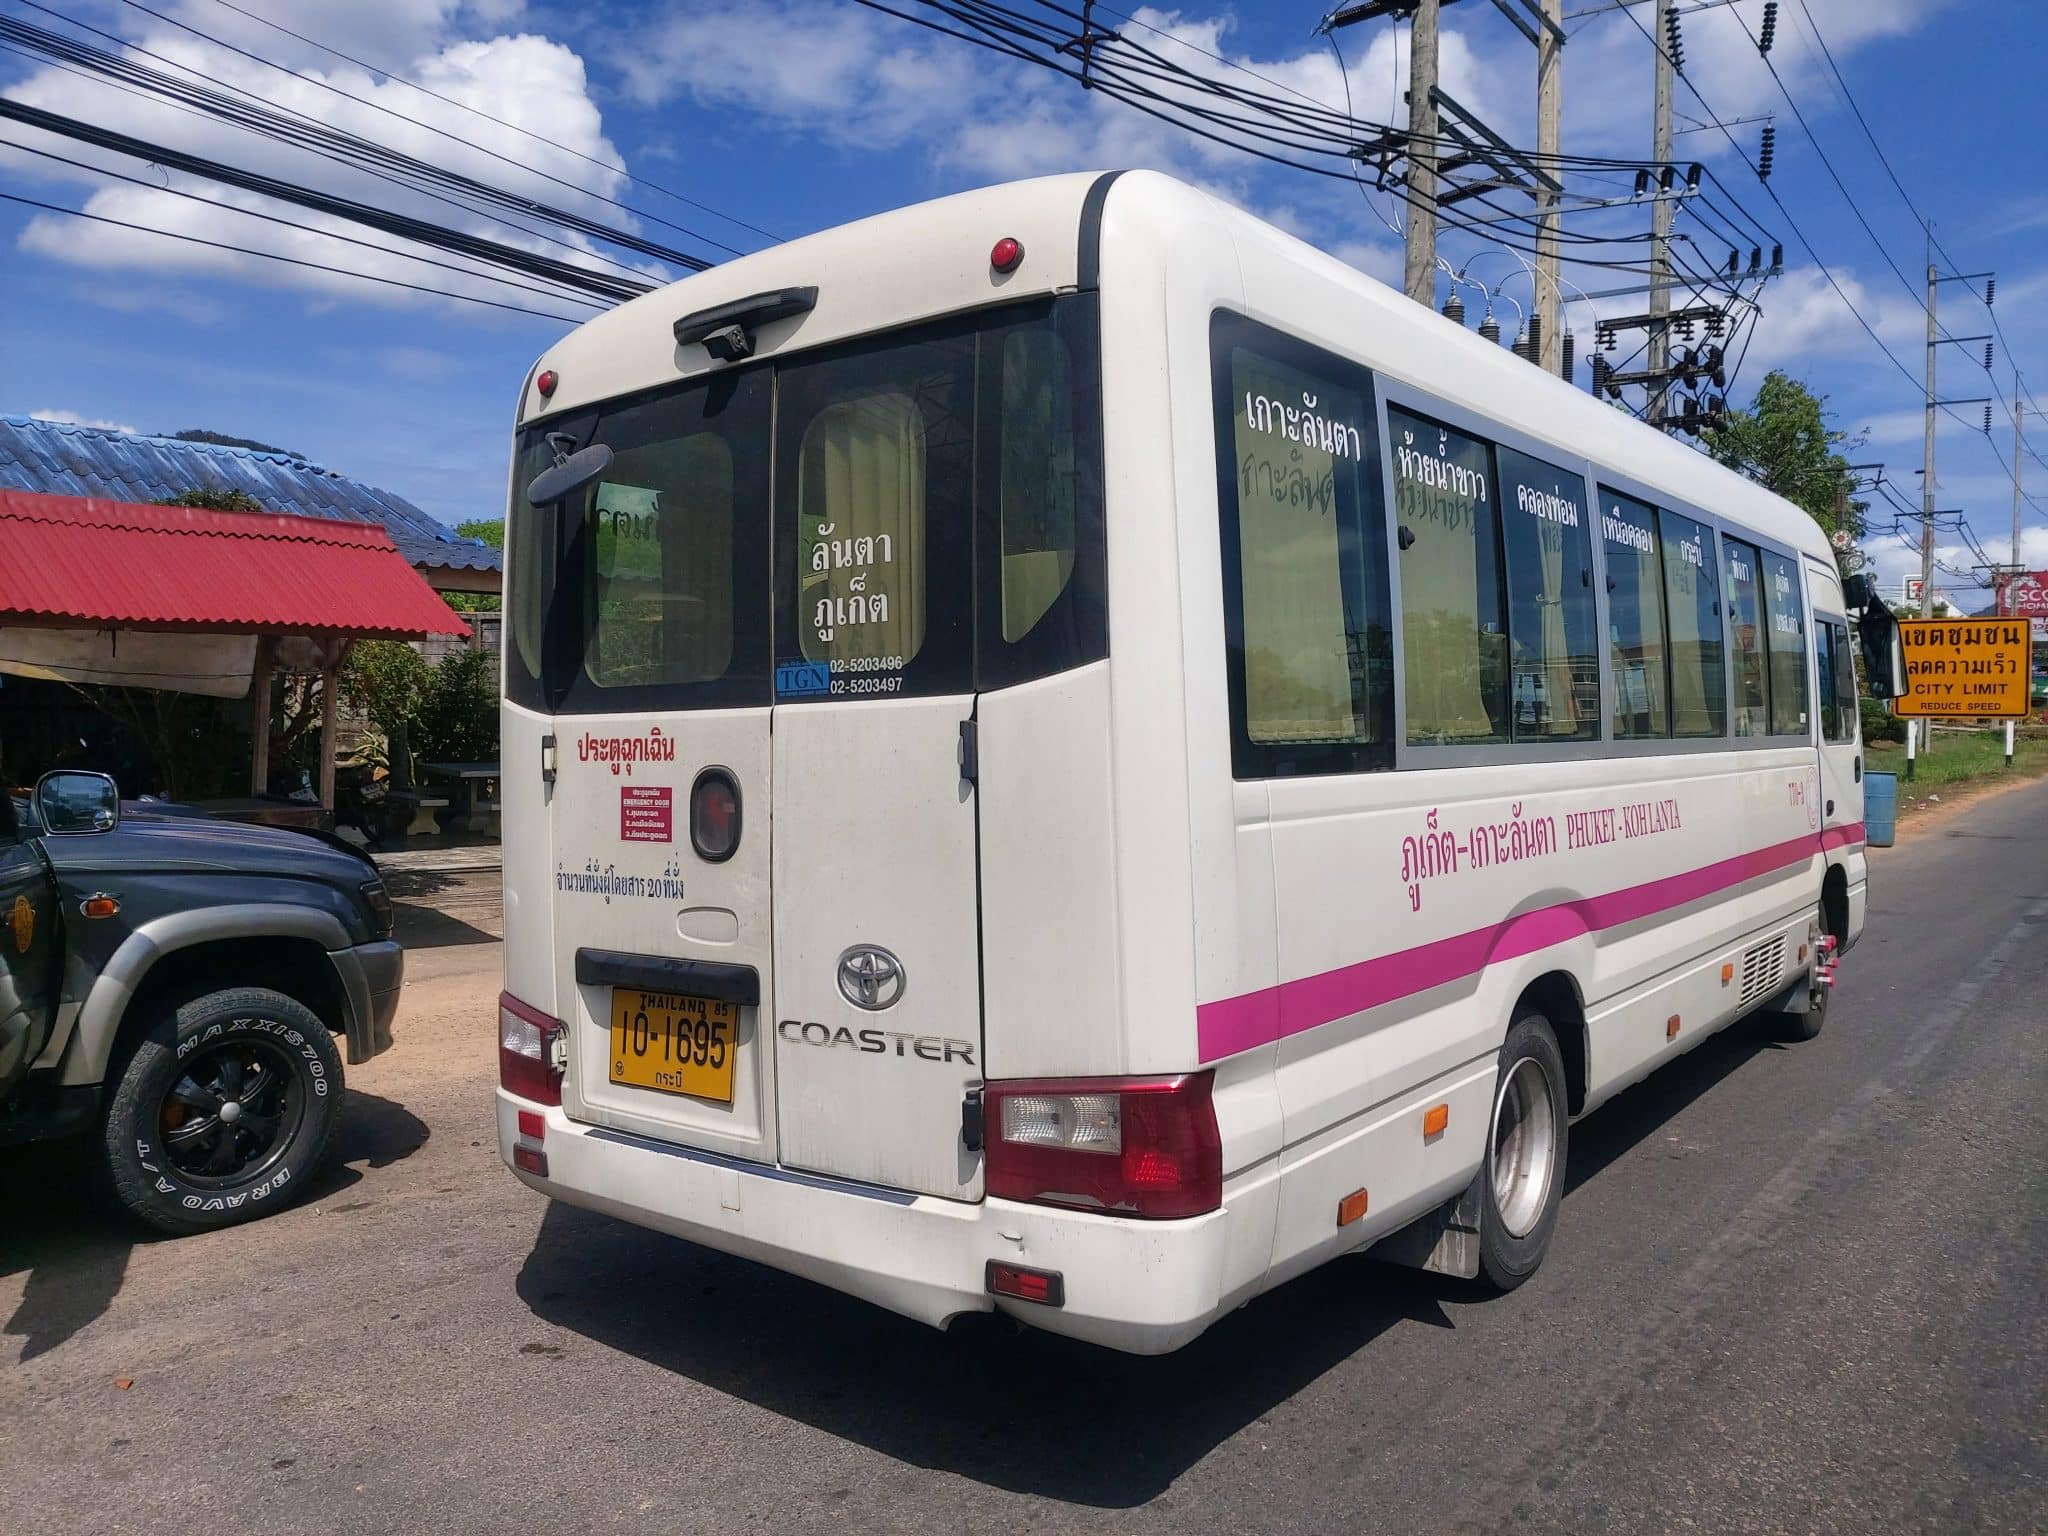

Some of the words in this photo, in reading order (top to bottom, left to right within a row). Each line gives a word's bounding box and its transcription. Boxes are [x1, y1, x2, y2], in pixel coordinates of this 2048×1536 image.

[1246, 391, 1361, 462] เกาะลันตา
[1398, 427, 1487, 503] ห้วยน้ำขาว
[1517, 484, 1579, 528] คลองท่อม
[811, 522, 892, 571] ลันตา
[1602, 505, 1654, 554] เหนือคลอง
[1680, 525, 1703, 568] กระบี่
[813, 571, 889, 642] ภูเก็ต
[2017, 602, 2048, 610] HOM
[1904, 626, 2021, 655] เขตชุมชน
[780, 669, 825, 690] TGN
[830, 656, 903, 674] 02-5203496
[1908, 653, 2017, 675] ลดความเร็ว
[830, 677, 903, 695] 02-5203497
[1915, 684, 1954, 695] CITY
[1963, 683, 2008, 695] LIMIT
[1920, 702, 1962, 711] REDUCE
[1967, 702, 2001, 711] SPEED
[577, 726, 676, 776] ประตูฉุกเฉิน
[1566, 808, 1616, 849] PHUKET
[648, 878, 662, 898] 20
[640, 994, 706, 1013] THAILAND
[714, 1003, 728, 1017] 85
[177, 1018, 304, 1059] MAXXIS
[301, 1044, 327, 1097] 700
[622, 1010, 728, 1069] 10-1695
[778, 1020, 976, 1065] COASTER
[656, 1067, 683, 1088] กระบี่
[182, 1168, 291, 1211] BRAVO
